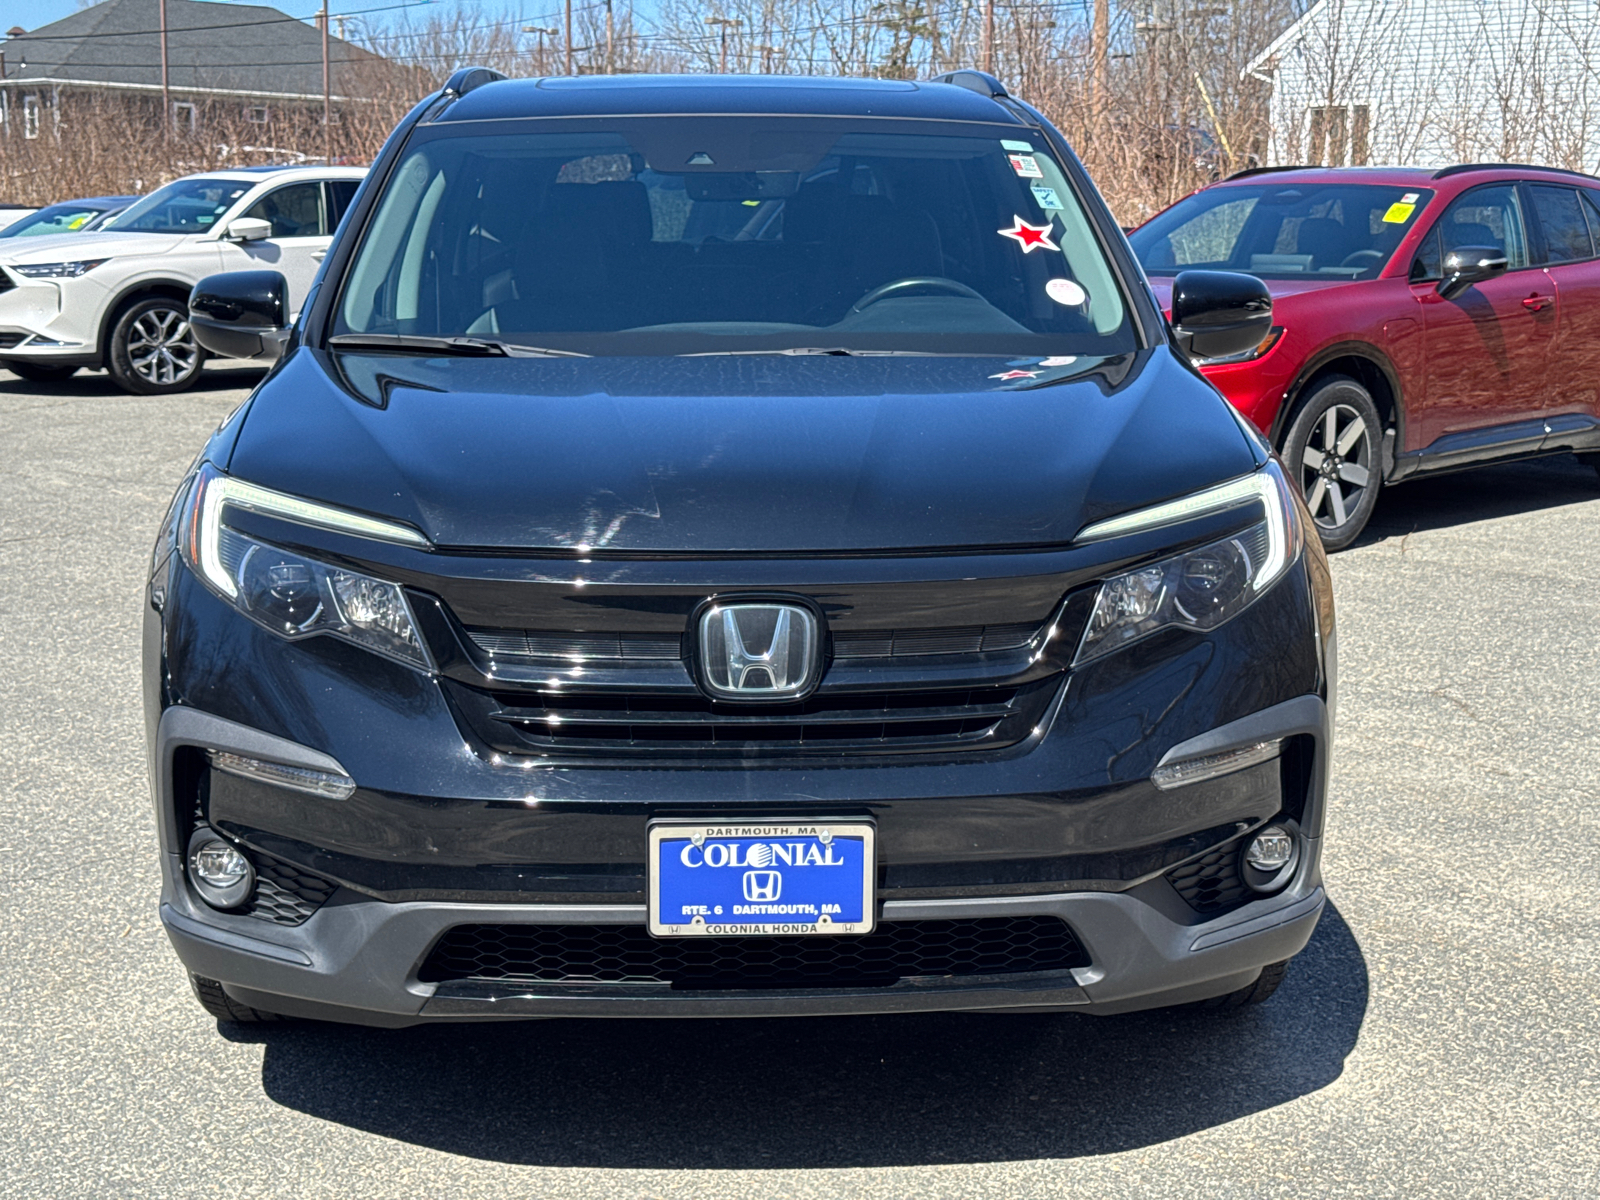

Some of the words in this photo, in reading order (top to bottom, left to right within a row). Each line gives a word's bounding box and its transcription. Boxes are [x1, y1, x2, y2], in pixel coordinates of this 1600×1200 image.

[680, 842, 844, 868] COLONIAL
[681, 905, 712, 915] RTE.
[713, 905, 723, 915] 6
[732, 904, 819, 916] DARTMOUTH,
[821, 903, 842, 914] MA
[705, 924, 769, 934] COLONIAL
[772, 924, 818, 933] HONDA
